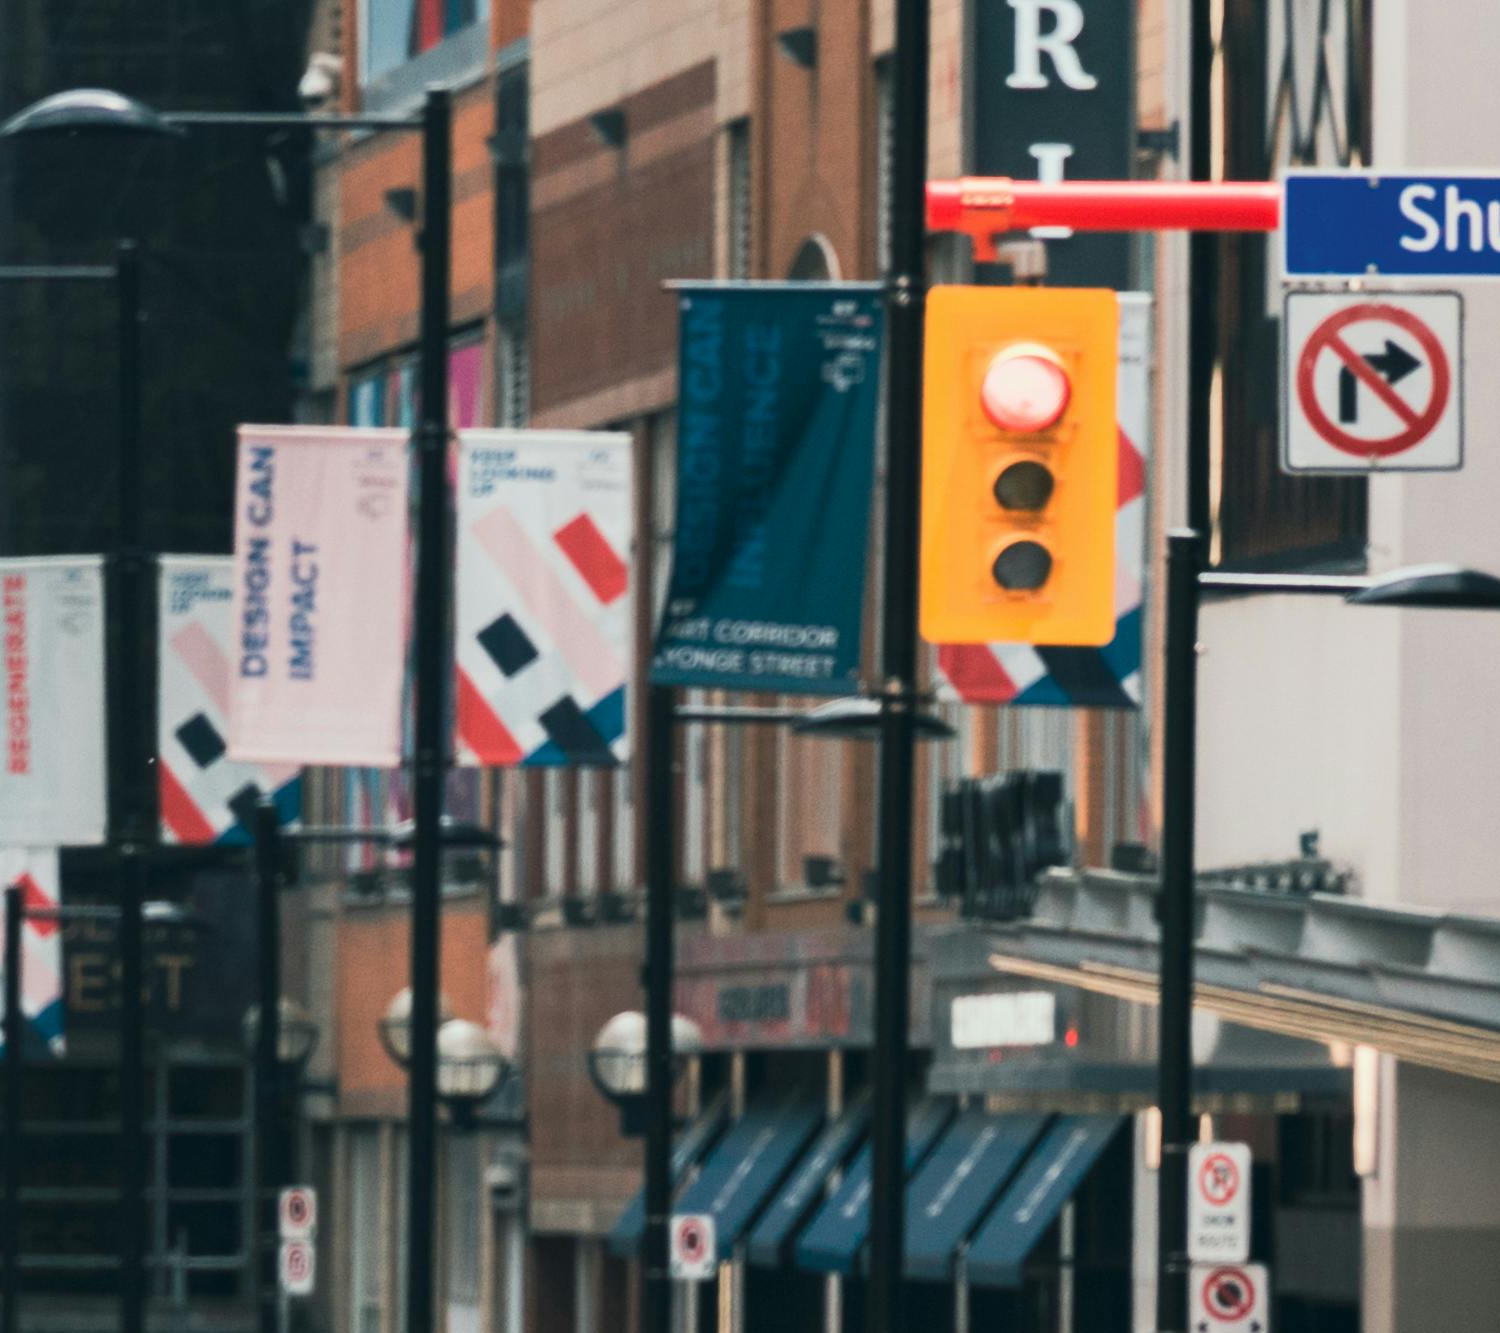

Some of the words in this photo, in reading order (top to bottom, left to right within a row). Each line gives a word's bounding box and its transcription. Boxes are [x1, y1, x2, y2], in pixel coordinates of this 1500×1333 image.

[246, 445, 276, 529] CAN
[727, 325, 780, 588] INUENCE
[3, 574, 31, 775] REGENERATE
[239, 537, 276, 679] DESIGN
[289, 540, 319, 681] IMPACT
[664, 646, 744, 673] YONGE
[750, 650, 836, 678] STREET
[713, 618, 839, 648] CORRIDOR
